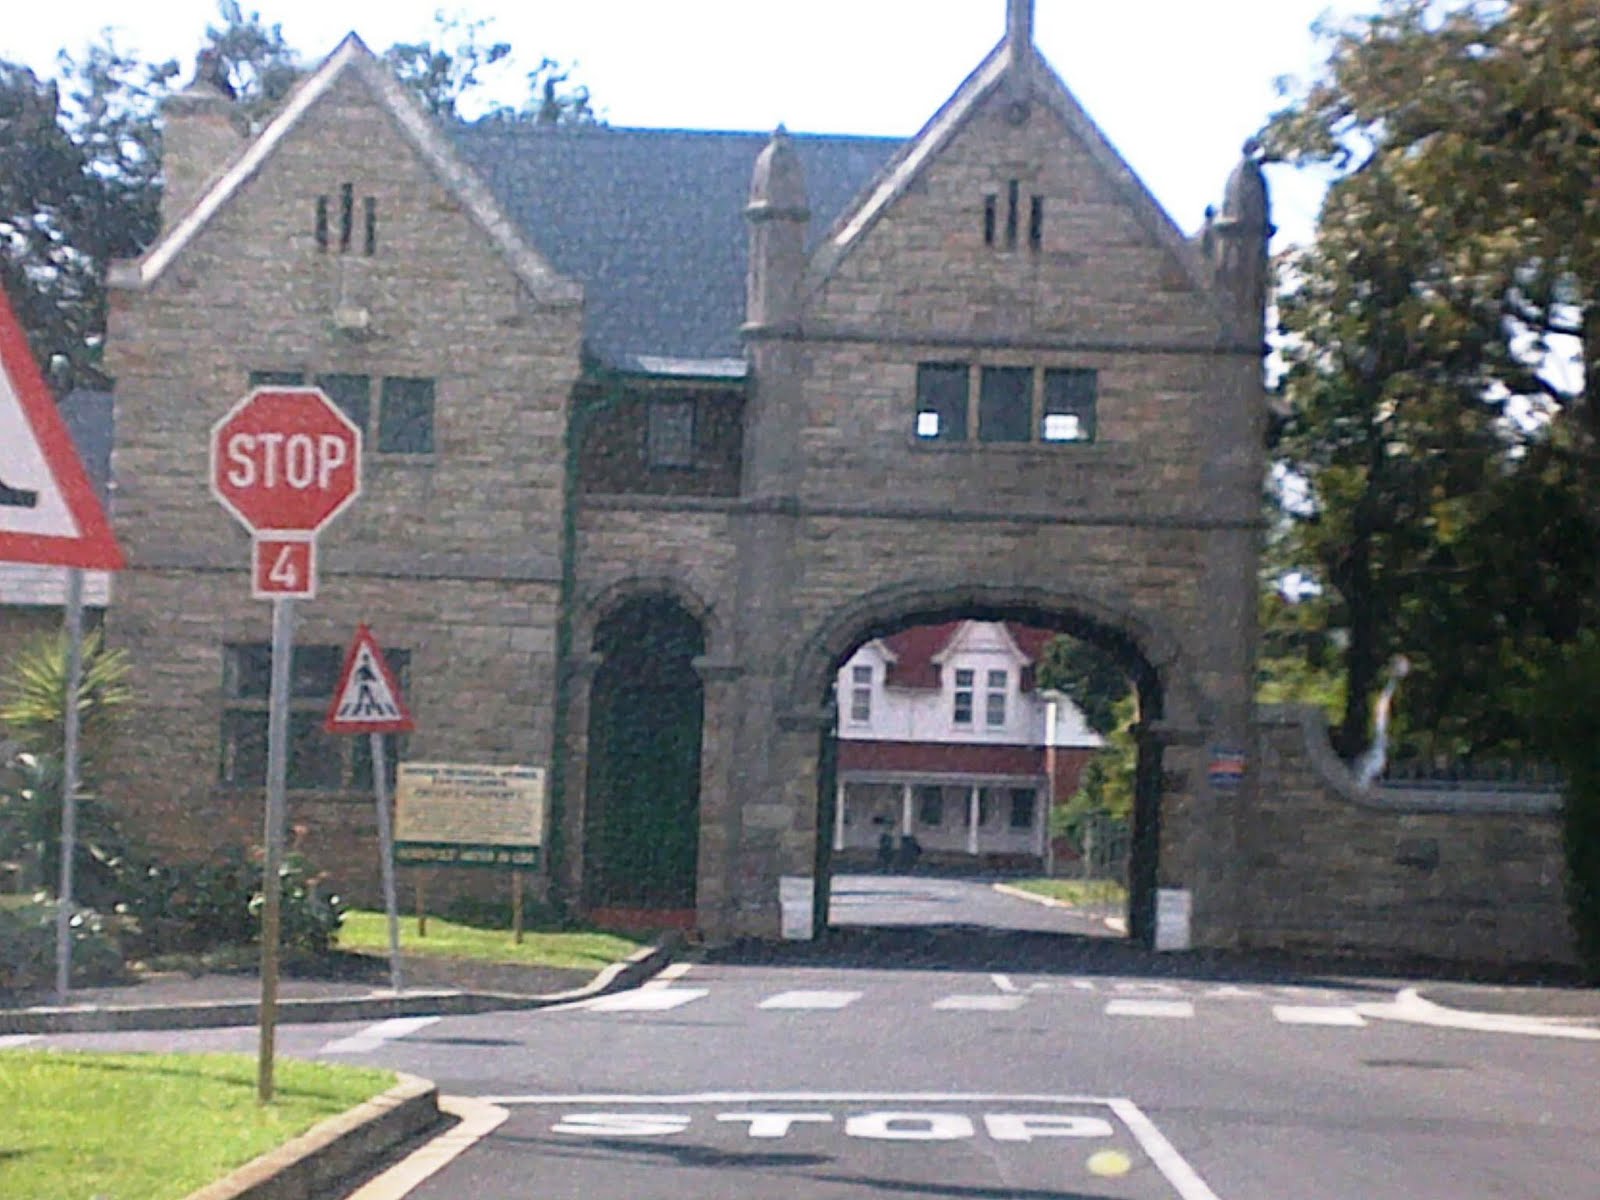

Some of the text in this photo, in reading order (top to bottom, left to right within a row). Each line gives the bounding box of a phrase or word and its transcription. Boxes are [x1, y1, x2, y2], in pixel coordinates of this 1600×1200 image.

[227, 433, 346, 488] STOP
[269, 545, 297, 588] 4
[551, 1111, 1114, 1142] STOP
